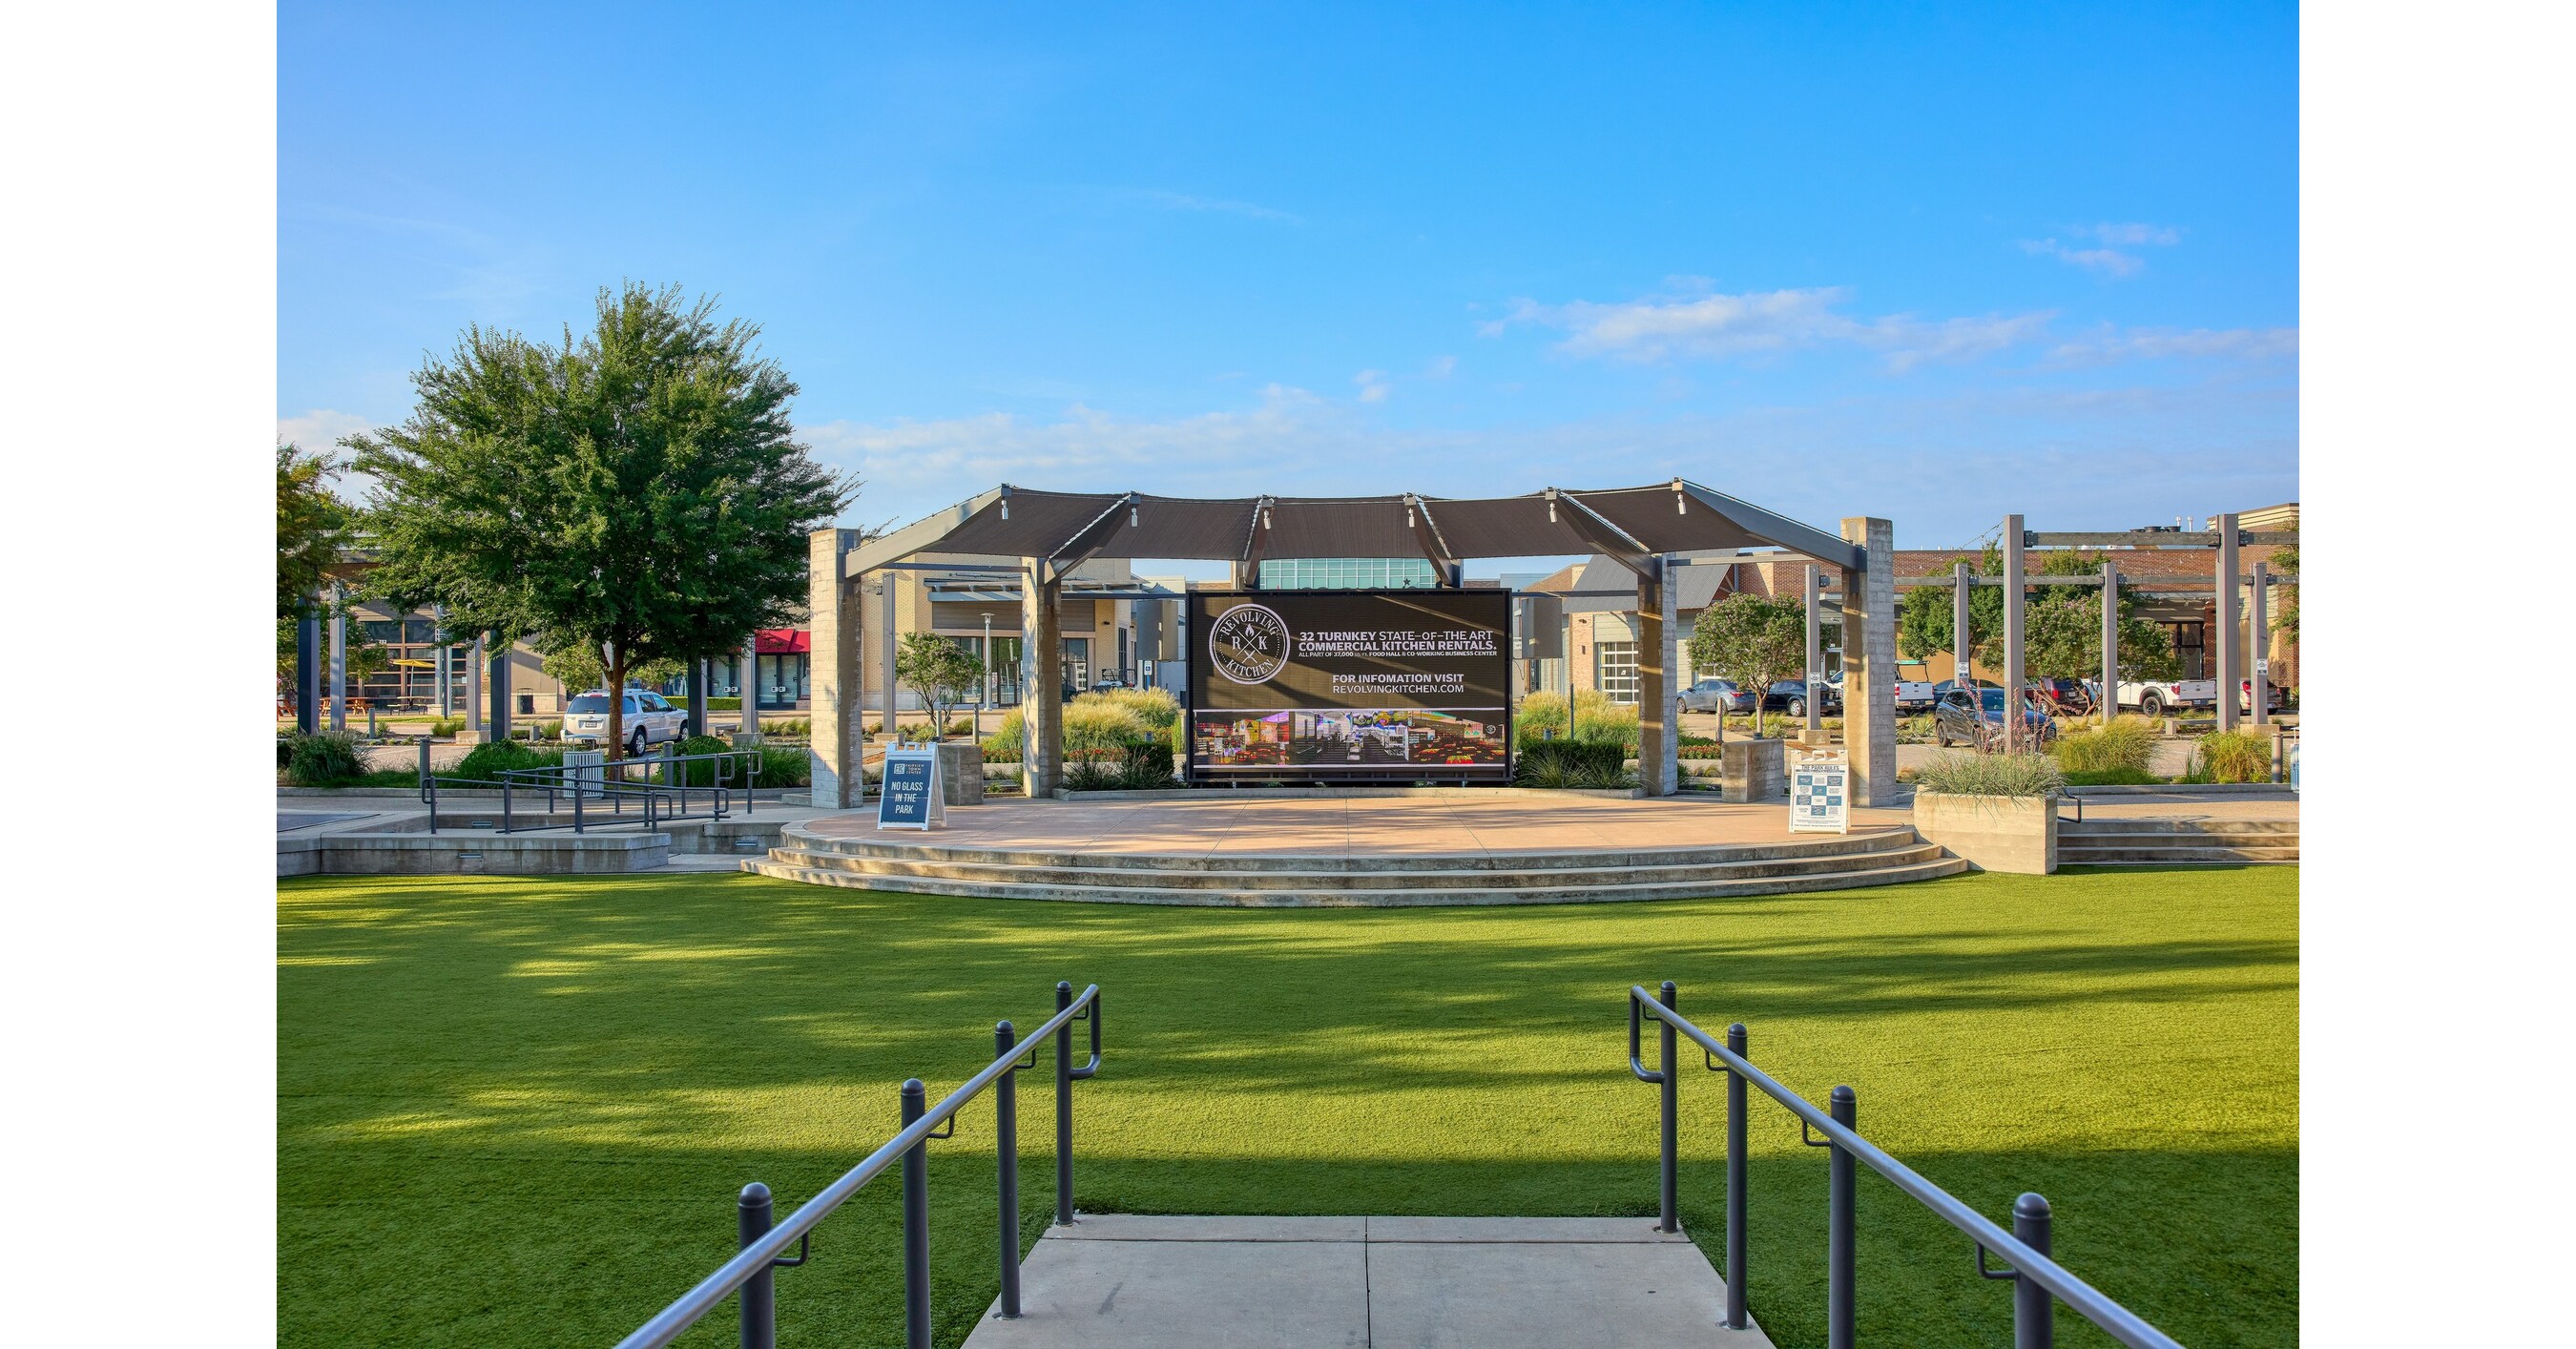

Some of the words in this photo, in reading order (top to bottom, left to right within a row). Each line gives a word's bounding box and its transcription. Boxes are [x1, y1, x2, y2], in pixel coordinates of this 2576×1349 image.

[1219, 611, 1279, 636] REVOLVING
[1299, 632, 1315, 641] 32
[1317, 632, 1377, 641] TURNKEY
[1468, 631, 1493, 640] ART
[1232, 635, 1241, 650] R
[1258, 635, 1268, 650] K
[1298, 641, 1380, 651] COMMERCIAL
[1381, 641, 1435, 651] KITCHEN
[1438, 640, 1497, 651] RENTALS.
[1226, 658, 1275, 677] KITCHEN
[1332, 674, 1356, 683] FOR
[1358, 674, 1431, 683] INFOMATION
[1434, 674, 1465, 682] VISIT
[1333, 685, 1465, 694] REVOLVINGKITCHEN.COM
[891, 781, 901, 791] NO
[902, 781, 924, 791] GLASS
[895, 793, 903, 802] IN
[904, 793, 917, 802] THE
[895, 804, 914, 814] PARK
